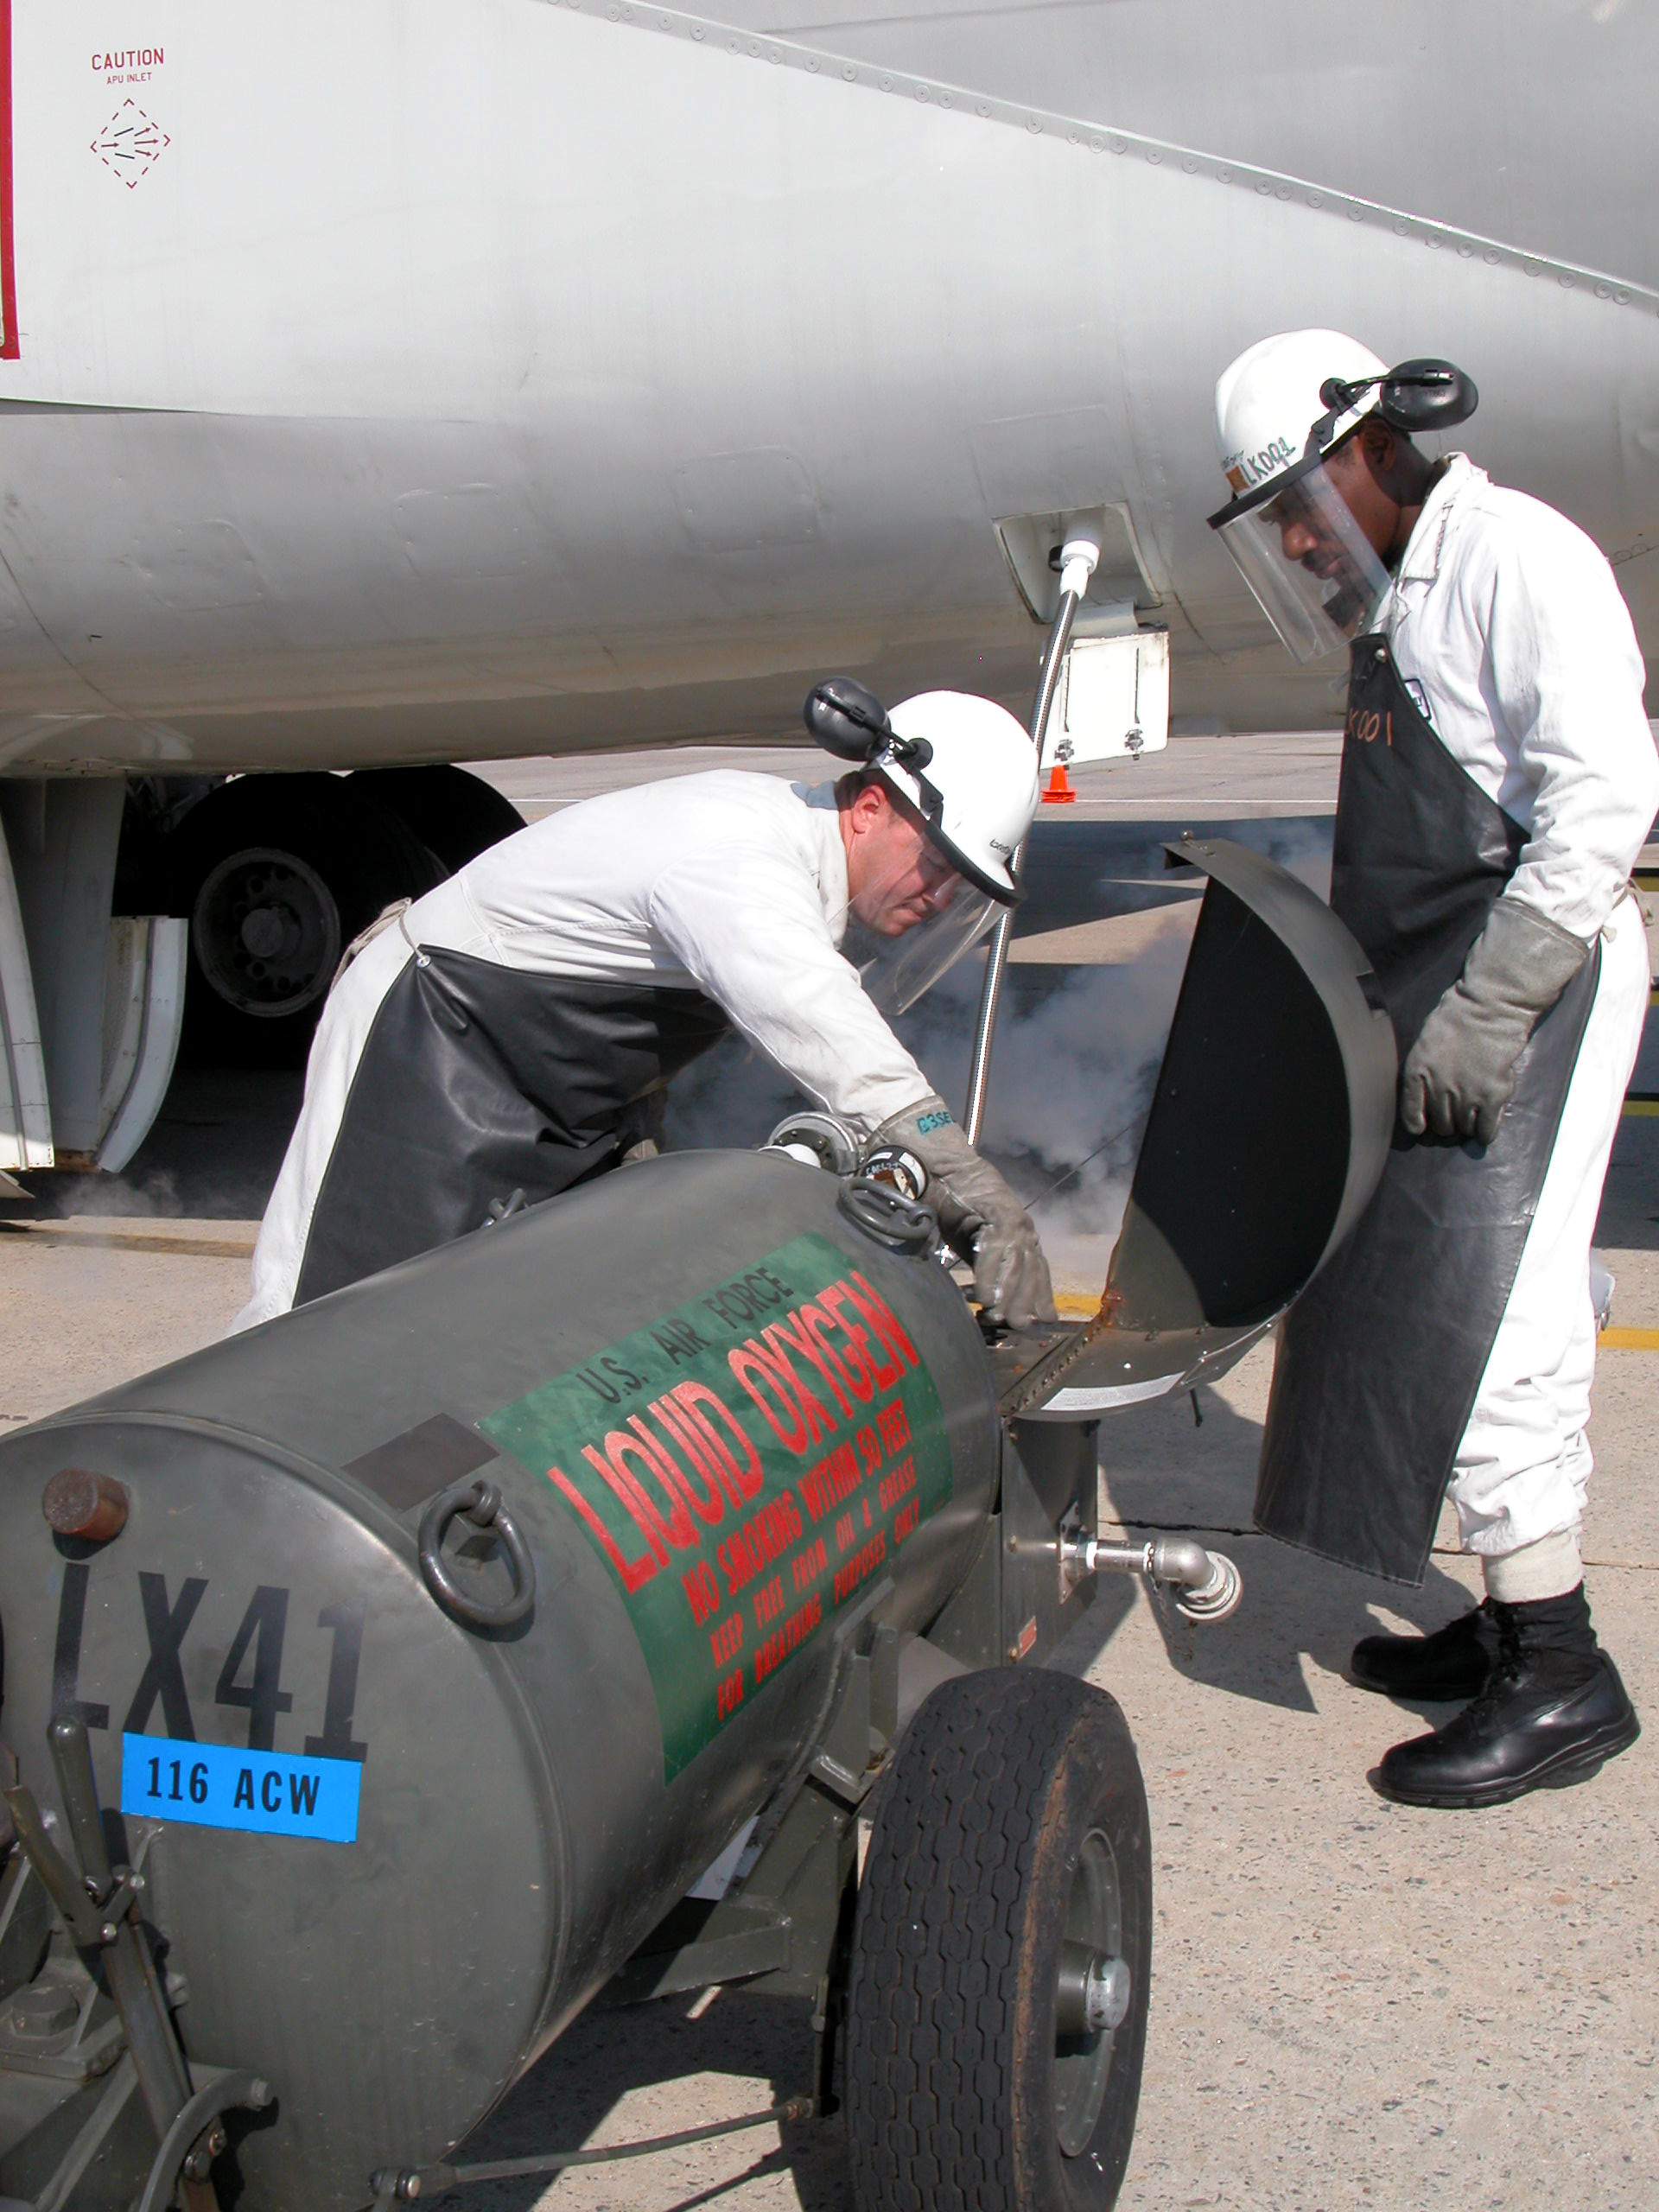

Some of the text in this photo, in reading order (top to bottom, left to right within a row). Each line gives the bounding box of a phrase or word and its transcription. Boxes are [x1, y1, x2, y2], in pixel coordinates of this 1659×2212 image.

[92, 48, 164, 70] CAUTION
[106, 72, 152, 85] APU INLET
[547, 1270, 919, 1594] LIQUID OXYGEN
[575, 1267, 794, 1404] U.S. AIR FORCE
[681, 1396, 912, 1627] NO SMOKING WITHIN 50 FEET
[710, 1611, 743, 1669] KEEP
[753, 1575, 785, 1630] FREE
[791, 1536, 828, 1593] FROM
[836, 1511, 855, 1553] OIL
[879, 1454, 917, 1512] GREASE
[716, 1496, 920, 1721] FOR BREATHING PURPOSES ONLY
[51, 1562, 368, 1763] LX41
[147, 1758, 321, 1815] 116 ACW
